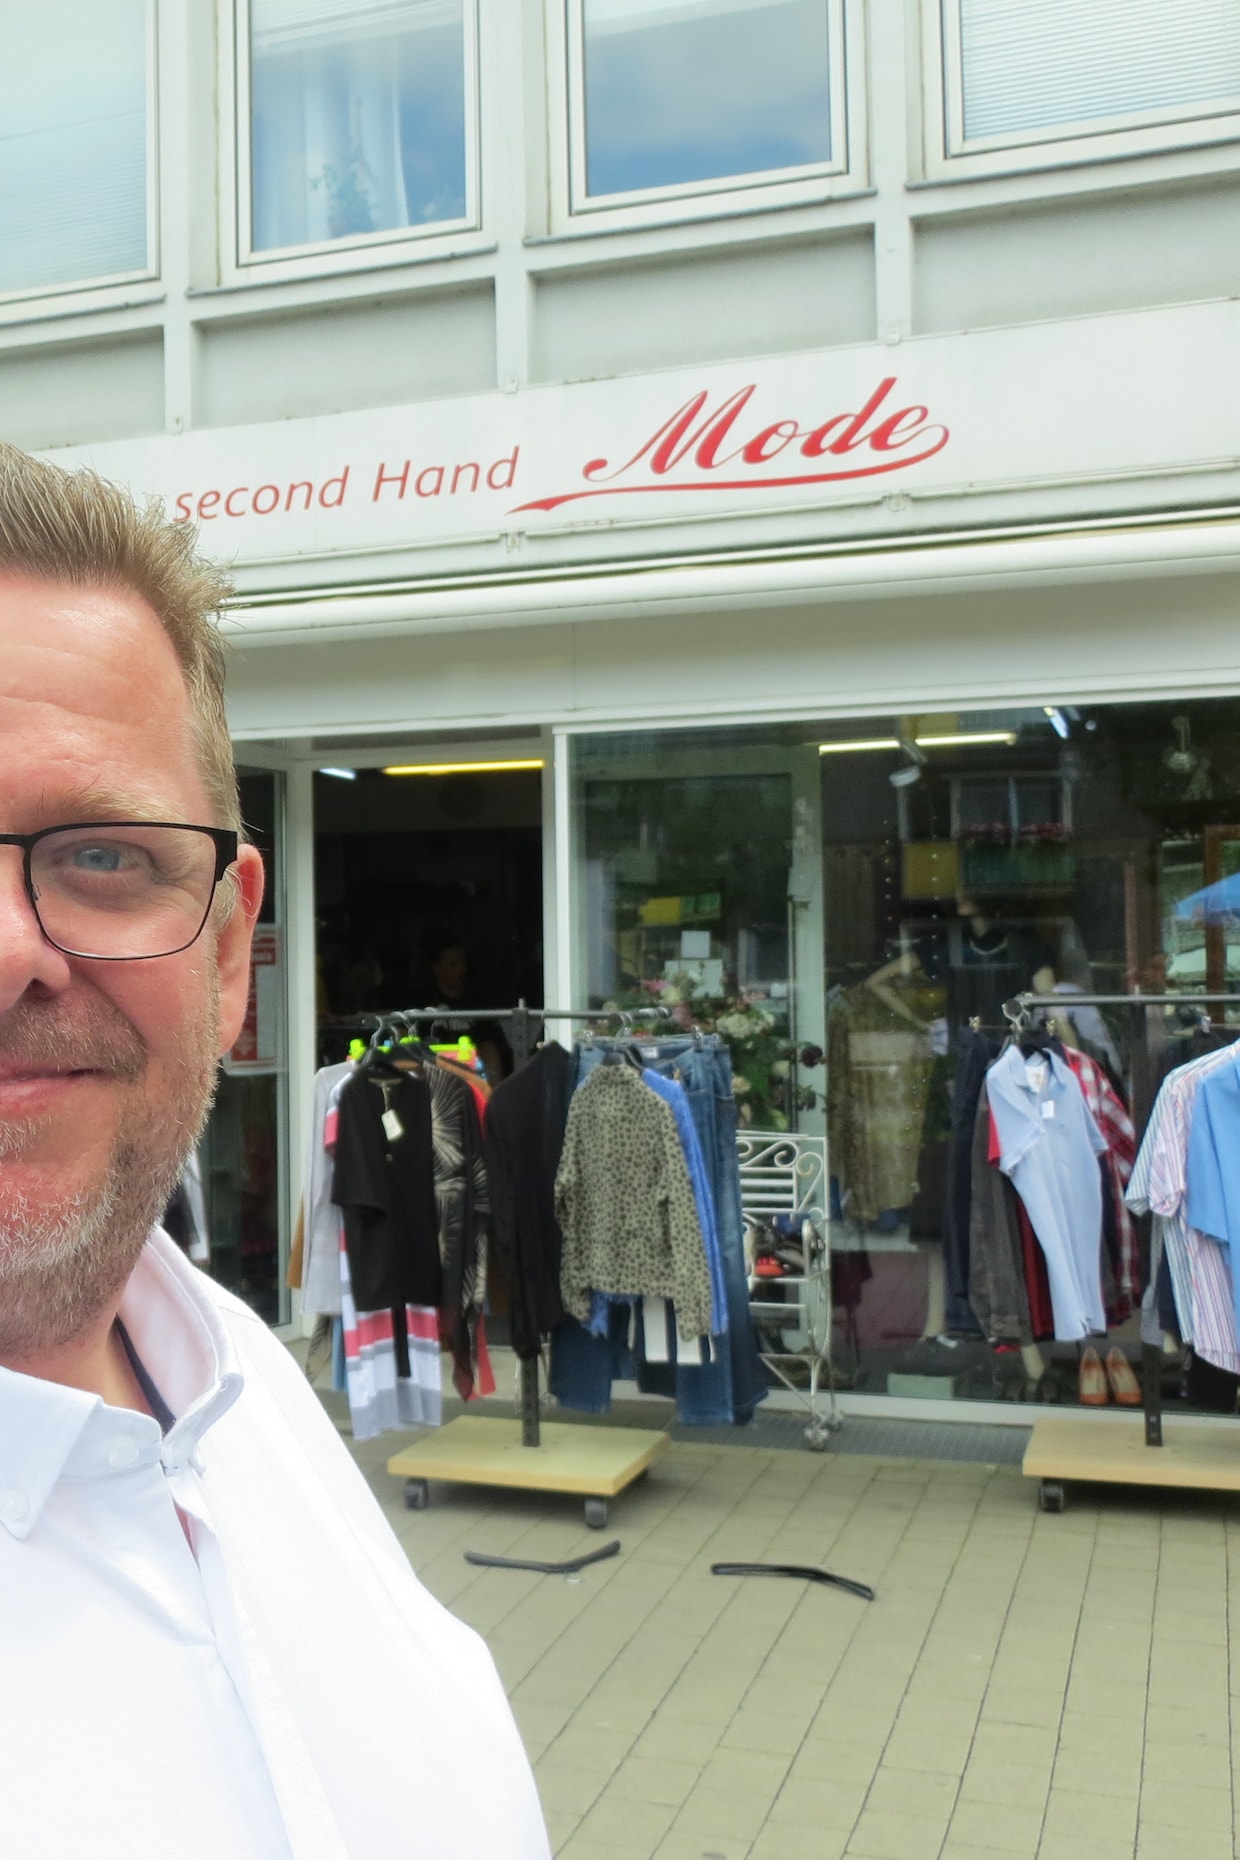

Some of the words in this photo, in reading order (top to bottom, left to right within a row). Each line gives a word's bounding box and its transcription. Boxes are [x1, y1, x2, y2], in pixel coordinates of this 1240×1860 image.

[172, 465, 350, 522] second
[371, 445, 520, 503] Hand
[575, 376, 949, 494] Mode
